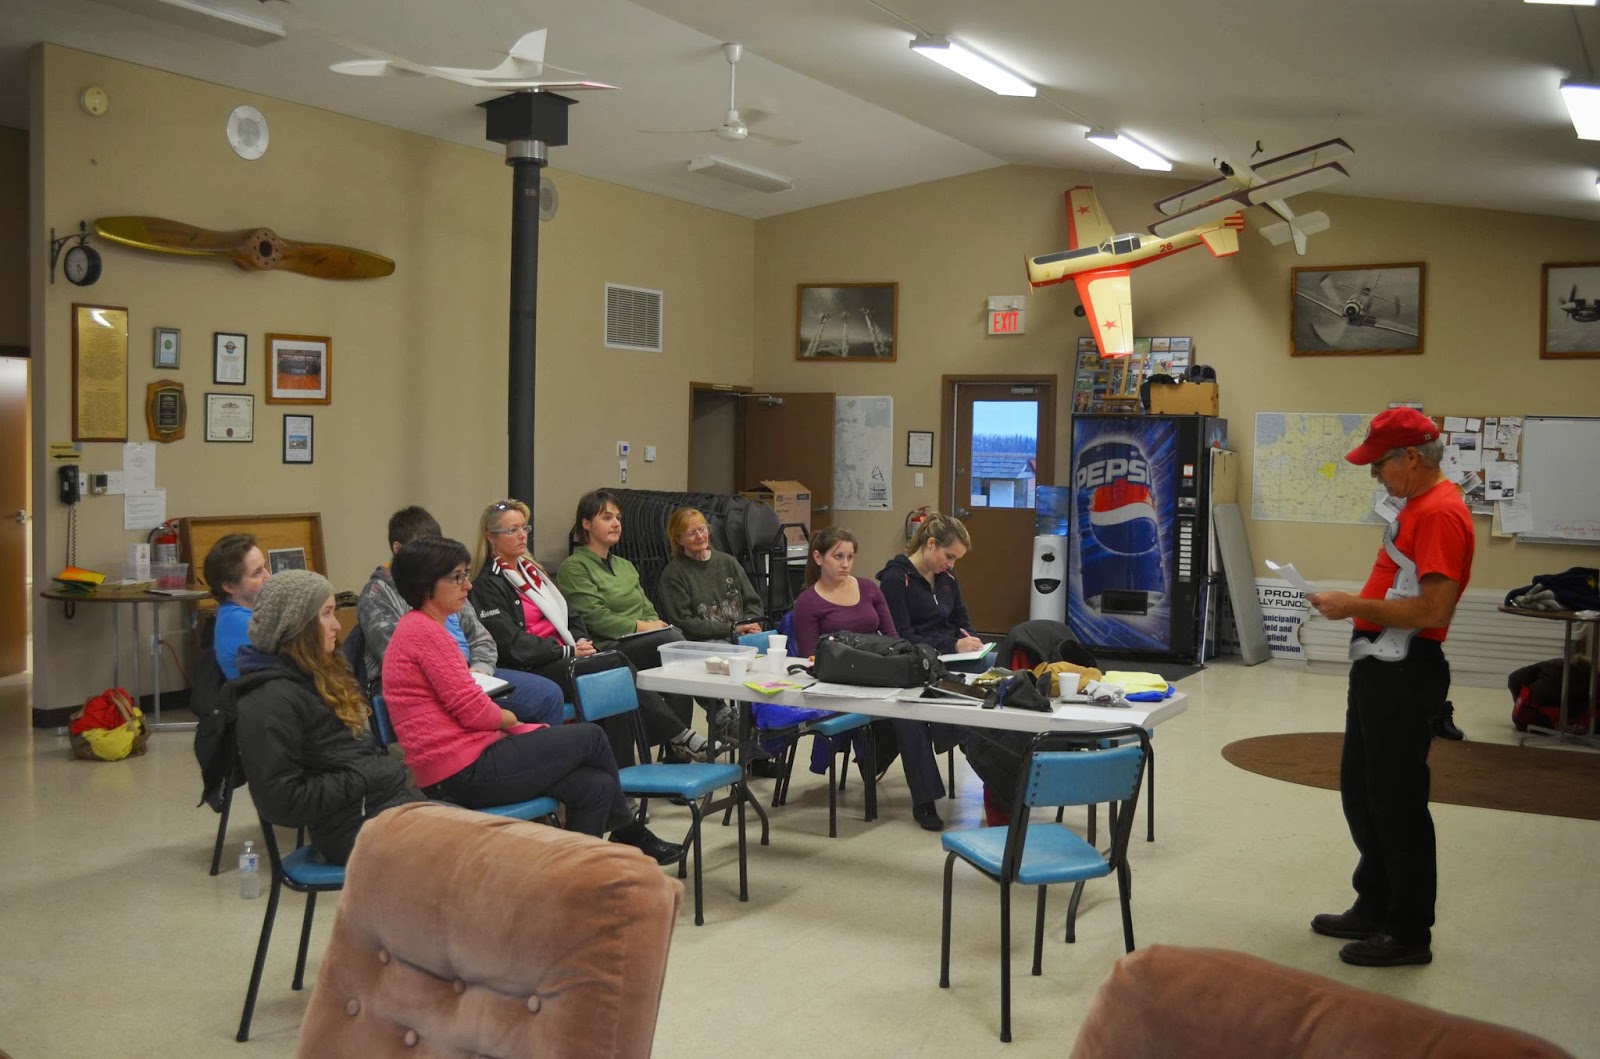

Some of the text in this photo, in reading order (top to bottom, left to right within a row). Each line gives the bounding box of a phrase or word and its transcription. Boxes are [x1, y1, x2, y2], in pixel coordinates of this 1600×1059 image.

[1160, 242, 1173, 253] 26
[993, 311, 1019, 333] EXIT
[1076, 458, 1151, 493] PEPSI
[1279, 625, 1292, 633] and
